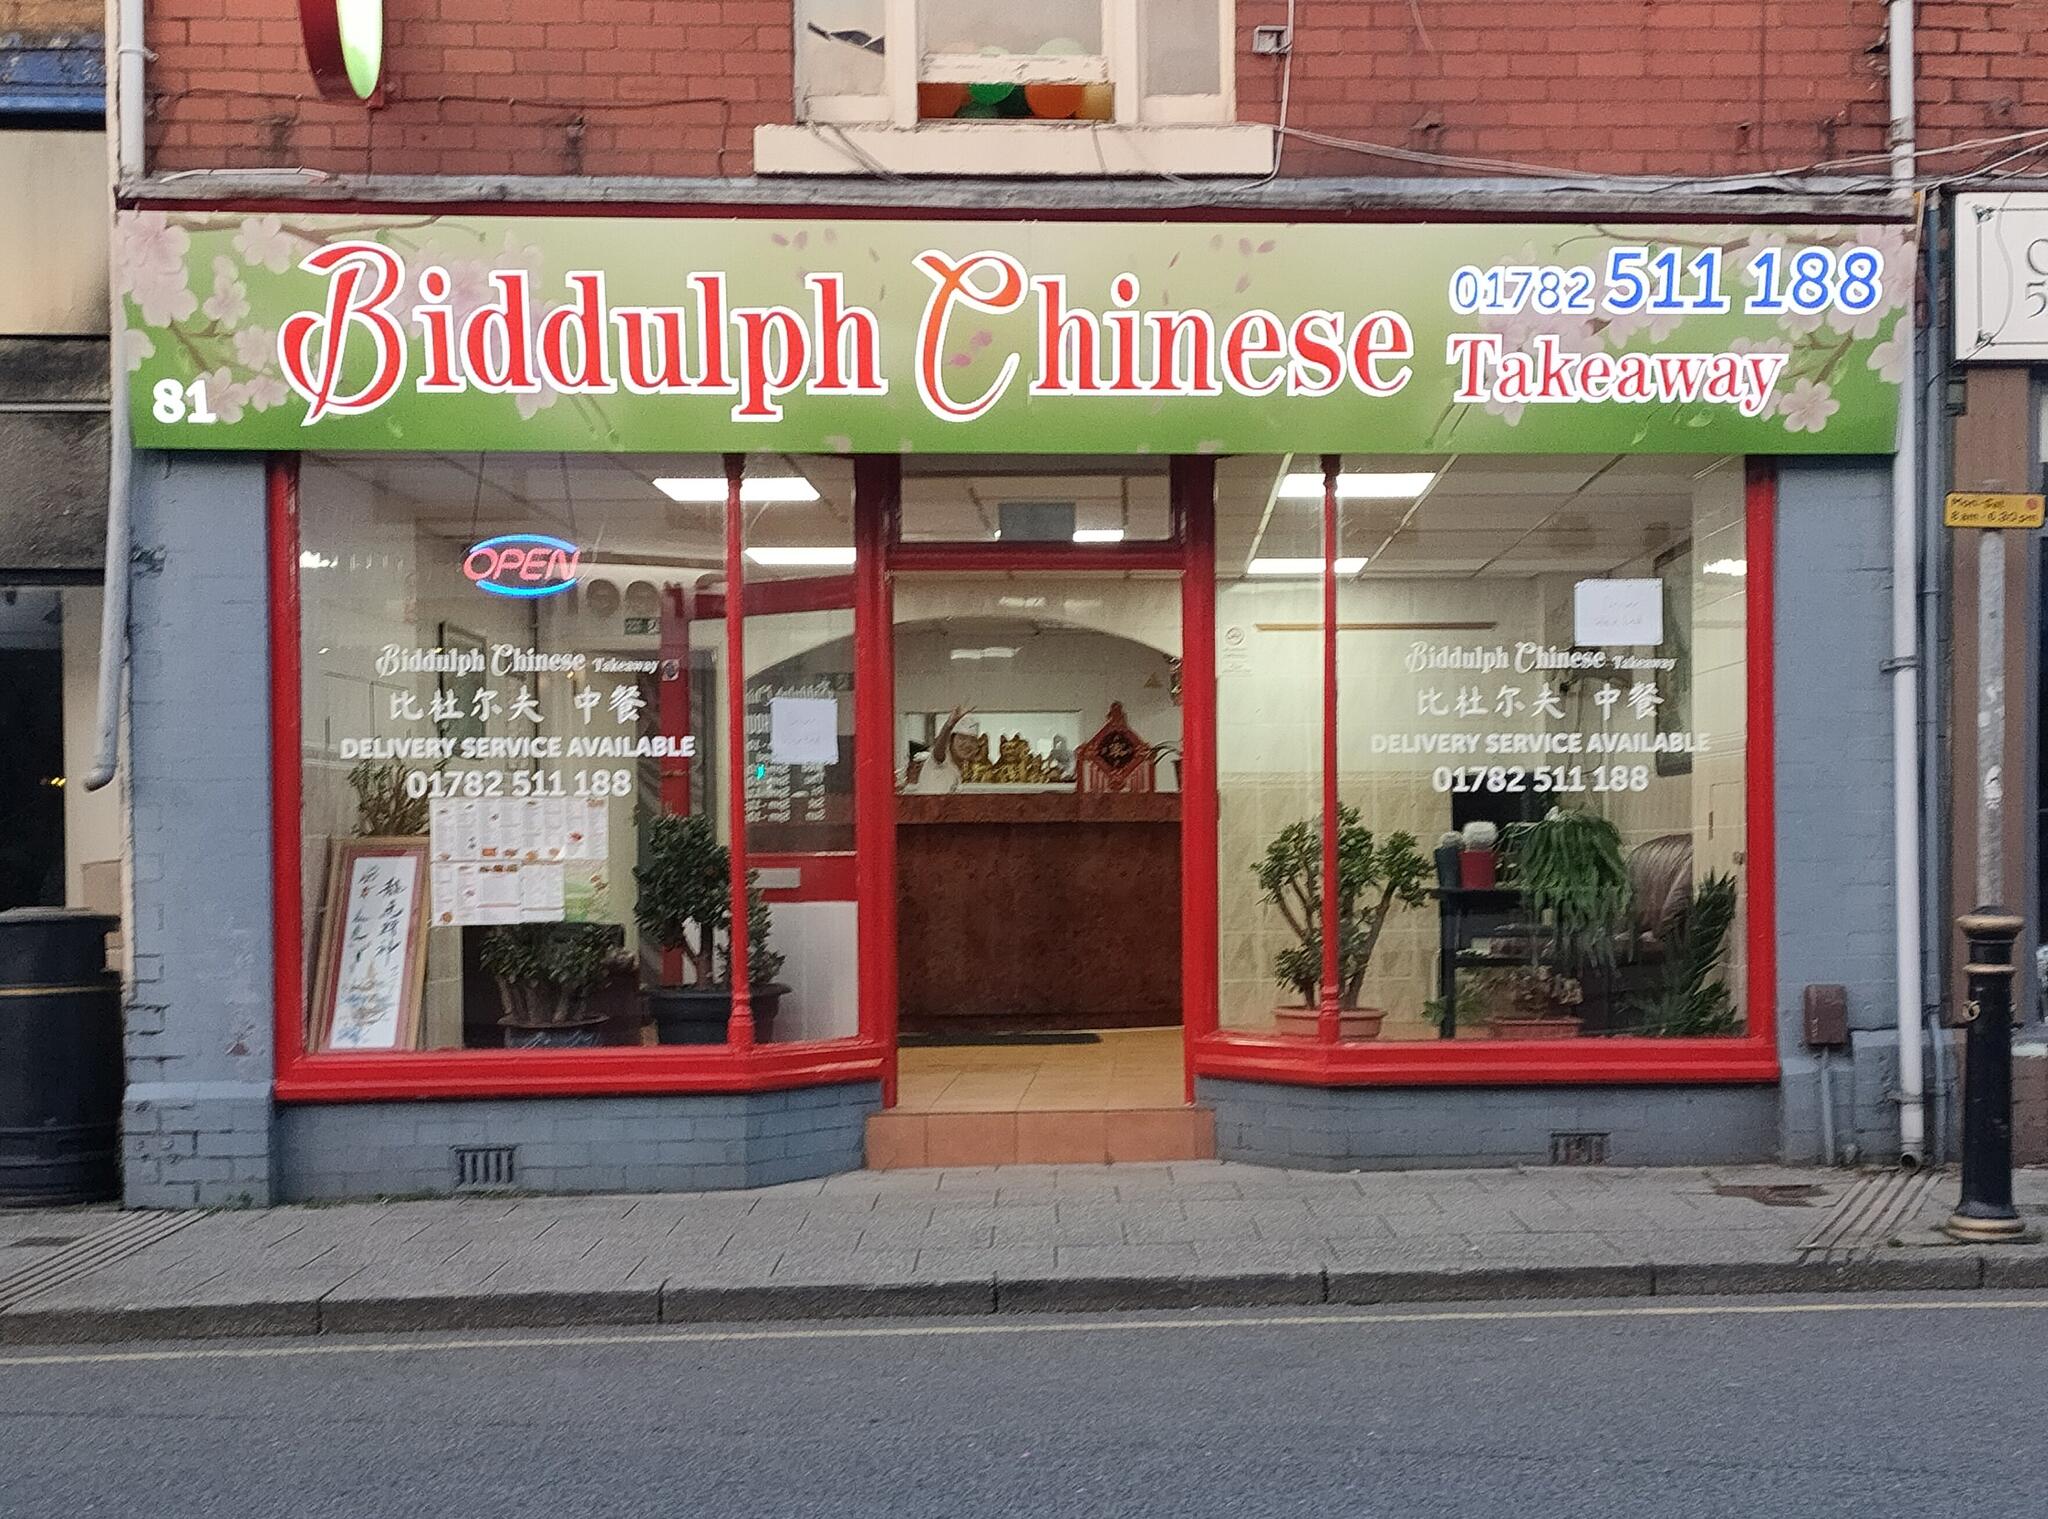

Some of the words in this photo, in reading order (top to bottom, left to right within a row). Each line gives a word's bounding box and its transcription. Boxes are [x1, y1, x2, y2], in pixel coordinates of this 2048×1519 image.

[1449, 265, 1595, 314] 01782
[1603, 246, 1731, 315] 511
[1745, 247, 1884, 315] 188
[277, 240, 889, 426] Biddulph
[911, 249, 1414, 422] Chinese
[1446, 333, 1788, 416] Takeaway
[152, 379, 216, 424] 81
[463, 547, 580, 581] OPEN
[375, 643, 485, 677] Biddulph
[490, 643, 586, 676] Chinese
[591, 657, 660, 674] Takeaway
[1405, 641, 1510, 674] Biddulph
[1514, 641, 1607, 674] Chinese
[1611, 655, 1678, 671] Takeaway
[389, 684, 545, 724] 比杜尔夫
[573, 684, 648, 725] 中餐
[1416, 682, 1567, 720] 比杜尔夫
[1593, 682, 1665, 721] 中餐
[340, 737, 457, 760] DELIVERY
[460, 736, 562, 759] SERVICE
[565, 735, 696, 758] AVAILABLE
[1370, 732, 1482, 755] DELIVERY
[1485, 732, 1583, 754] SERVICE
[1586, 732, 1711, 753] AVAILABLE
[405, 769, 504, 799] 01782
[511, 769, 566, 797] 511
[573, 769, 632, 797] 188
[1432, 765, 1527, 793] 01782
[1532, 765, 1586, 793] 511
[1592, 765, 1650, 793] 188
